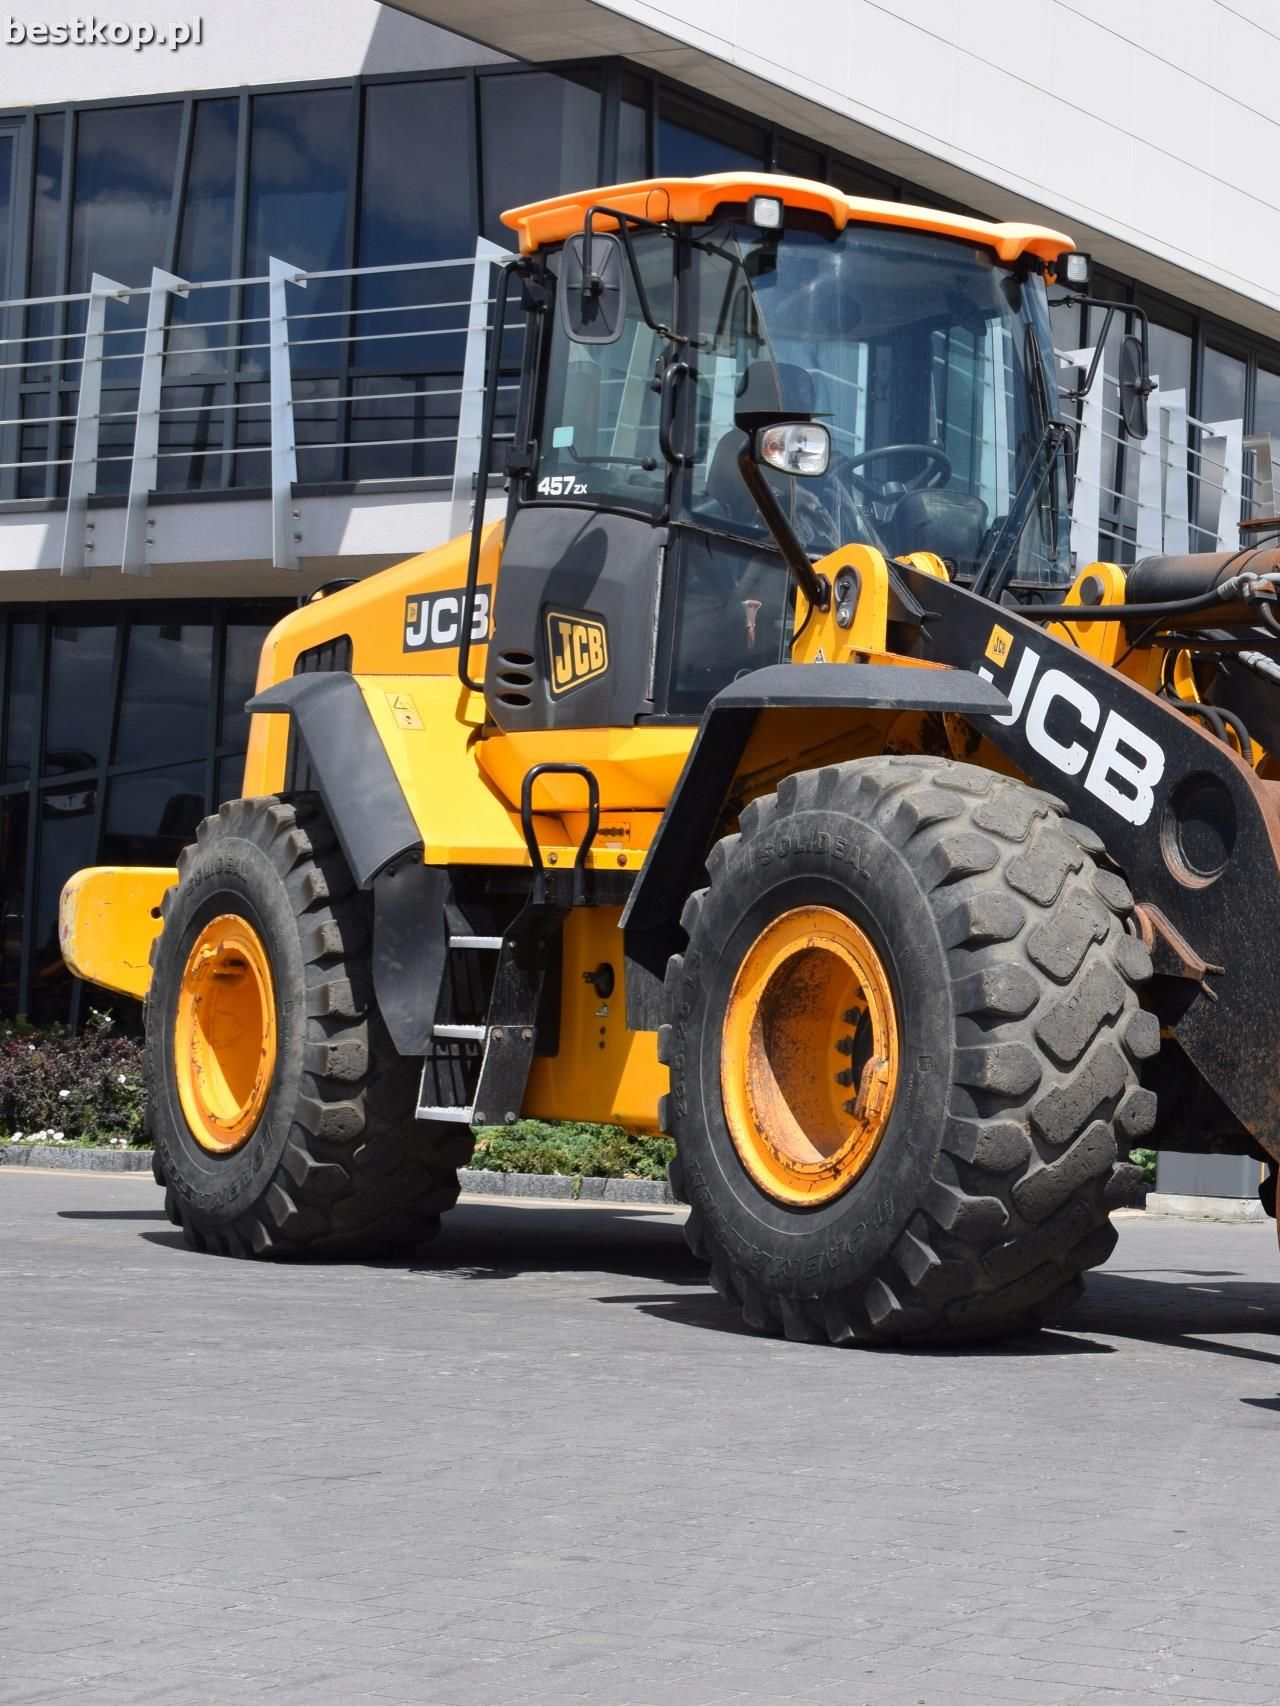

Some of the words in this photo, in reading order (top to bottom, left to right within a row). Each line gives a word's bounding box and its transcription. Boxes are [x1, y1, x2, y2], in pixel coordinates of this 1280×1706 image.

[406, 593, 489, 647] JCB
[555, 621, 604, 685] JCB
[978, 646, 1166, 826] JCB
[759, 831, 872, 880] SOLIDEAL
